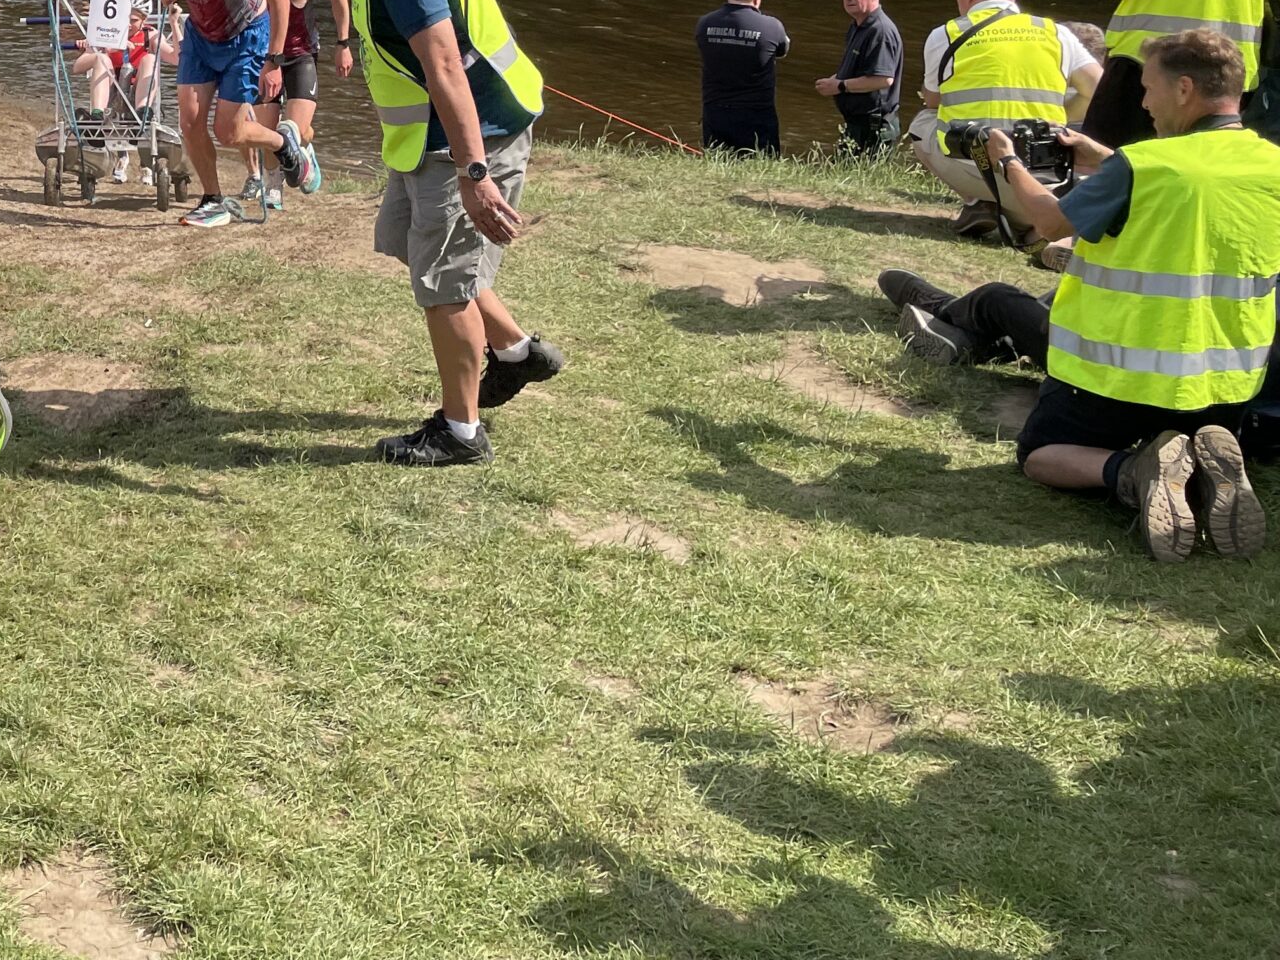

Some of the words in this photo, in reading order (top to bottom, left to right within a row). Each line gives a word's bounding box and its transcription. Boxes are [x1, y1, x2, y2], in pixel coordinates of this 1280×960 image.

[96, 26, 120, 34] Piccadilly
[706, 26, 736, 37] MEDICAL
[738, 29, 762, 40] STAFF
